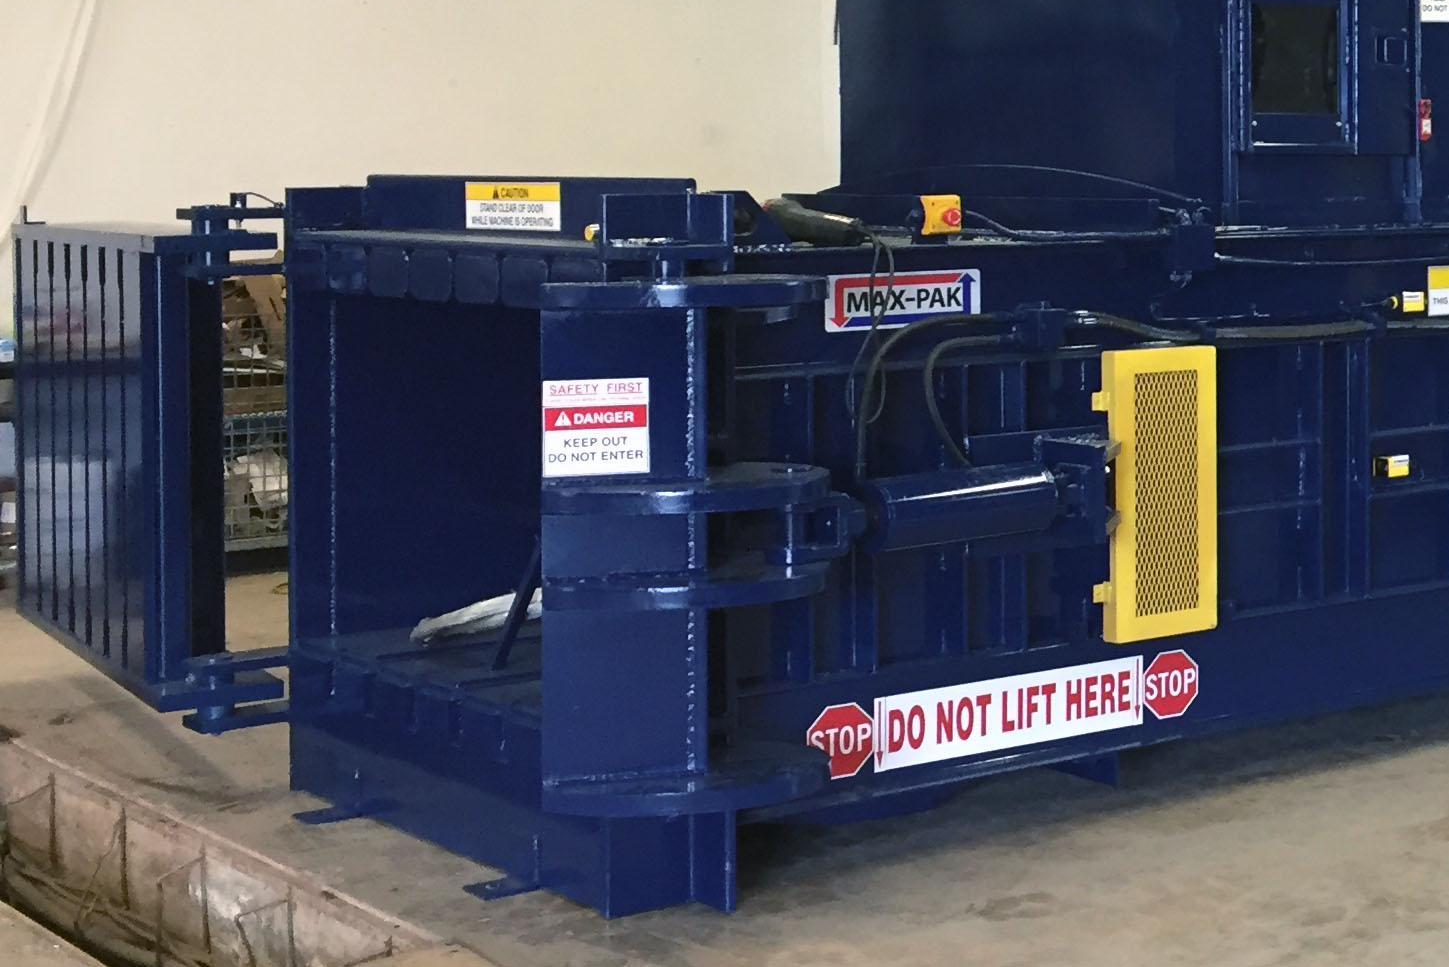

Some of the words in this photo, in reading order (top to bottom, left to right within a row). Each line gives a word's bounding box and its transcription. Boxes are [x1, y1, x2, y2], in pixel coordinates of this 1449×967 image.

[1422, 4, 1433, 12] DO
[1434, 4, 1448, 12] NOT
[501, 187, 528, 198] CAUTION
[480, 203, 497, 212] STAND
[499, 203, 516, 212] CLEAR
[518, 203, 526, 212] OF
[527, 204, 544, 213] DOOR
[472, 216, 488, 225] WHILE
[489, 216, 513, 226] MACHINE
[514, 217, 521, 226] IS
[522, 217, 553, 227] OPERATING
[846, 287, 962, 313] MAX-PAK
[1433, 297, 1448, 305] THIS
[549, 384, 599, 395] SAFETY
[607, 382, 642, 392] FIRST
[573, 411, 634, 425] DANGER
[564, 438, 597, 448] KEEP
[601, 436, 628, 446] OUT
[548, 453, 567, 463] DO
[571, 452, 597, 462] NOT
[601, 450, 643, 460] ENTER
[1145, 668, 1196, 700] STOP
[888, 704, 925, 753] DO
[936, 693, 992, 745] NOT
[1001, 683, 1057, 733] LIFT
[1066, 670, 1131, 722] HERE
[810, 723, 872, 755] STOP
